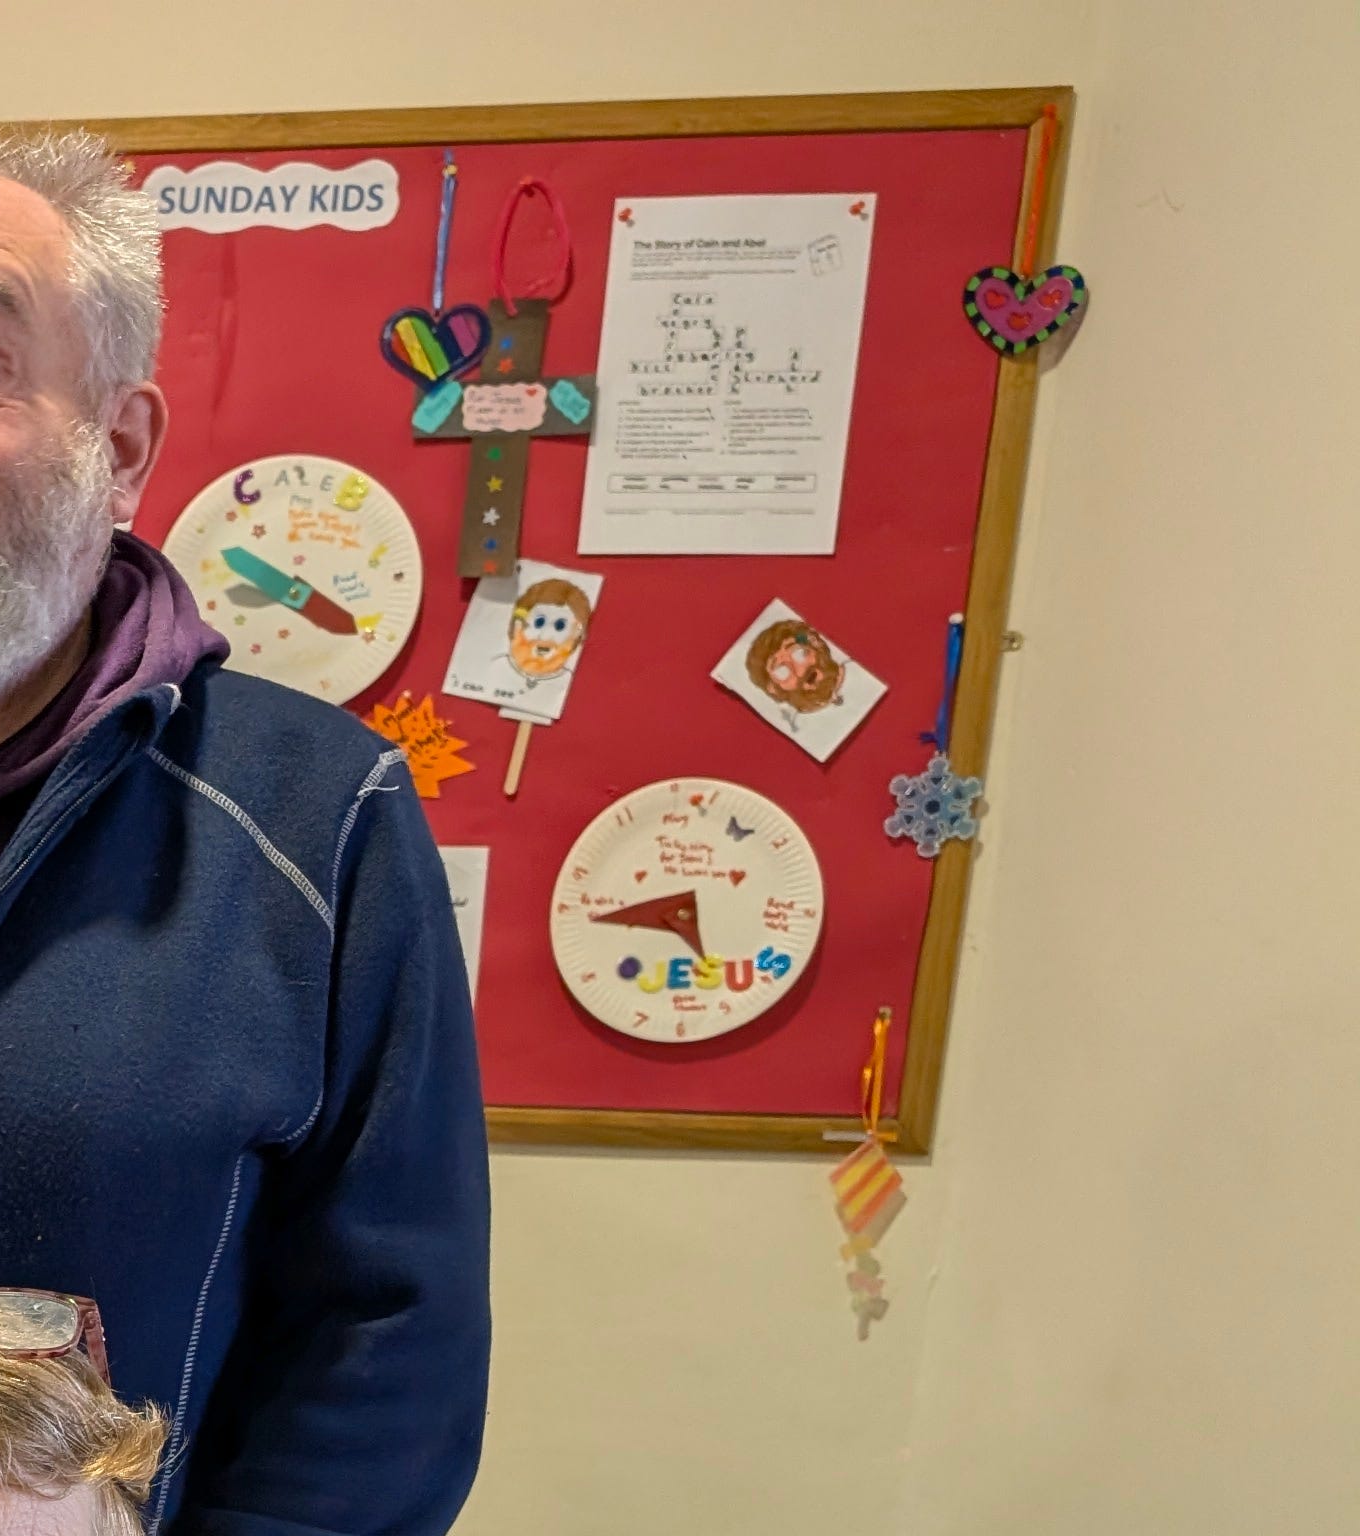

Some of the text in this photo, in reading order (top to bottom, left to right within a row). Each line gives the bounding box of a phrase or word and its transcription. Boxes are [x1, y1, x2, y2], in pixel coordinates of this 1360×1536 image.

[158, 183, 384, 214] SUNDAY KIDS
[636, 946, 792, 994] JESUS
